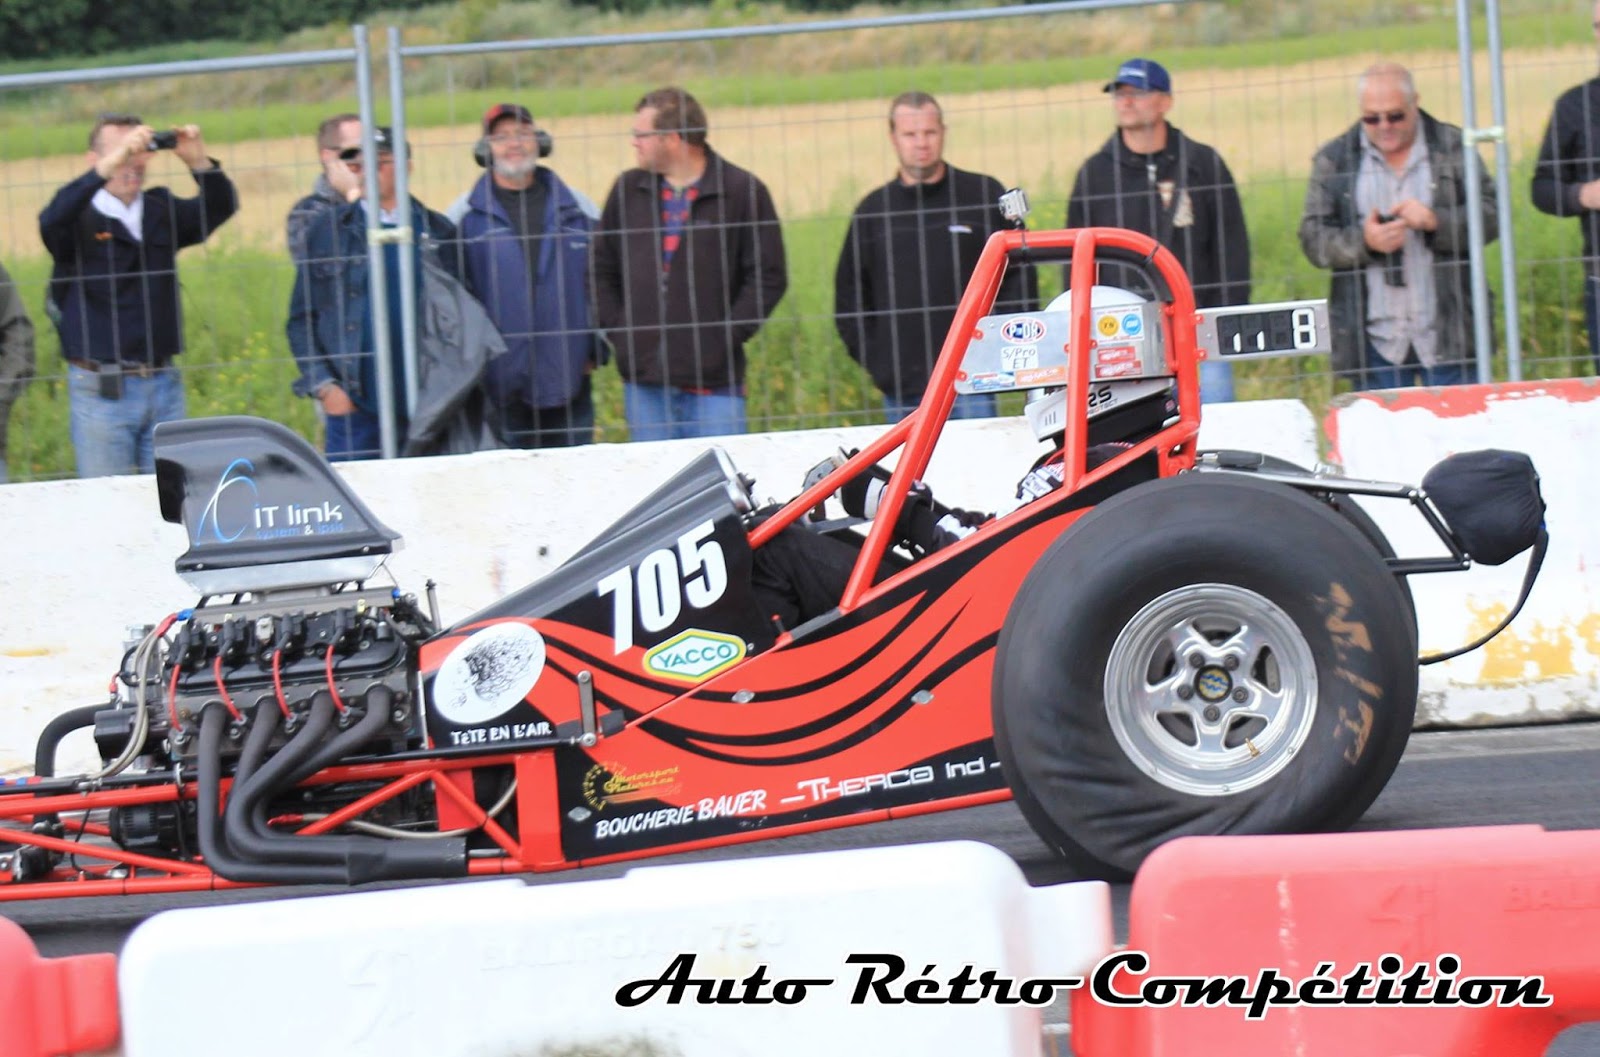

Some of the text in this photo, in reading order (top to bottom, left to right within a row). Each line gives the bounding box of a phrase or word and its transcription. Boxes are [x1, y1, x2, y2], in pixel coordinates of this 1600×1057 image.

[1012, 357, 1031, 370] ET
[287, 500, 344, 526] link
[596, 517, 728, 657] 705
[657, 643, 733, 669] YACCO
[489, 725, 511, 742] EN
[513, 721, 553, 739] L'AIR
[945, 756, 986, 779] Ind
[594, 788, 768, 839] BOUCHERIE BAUER
